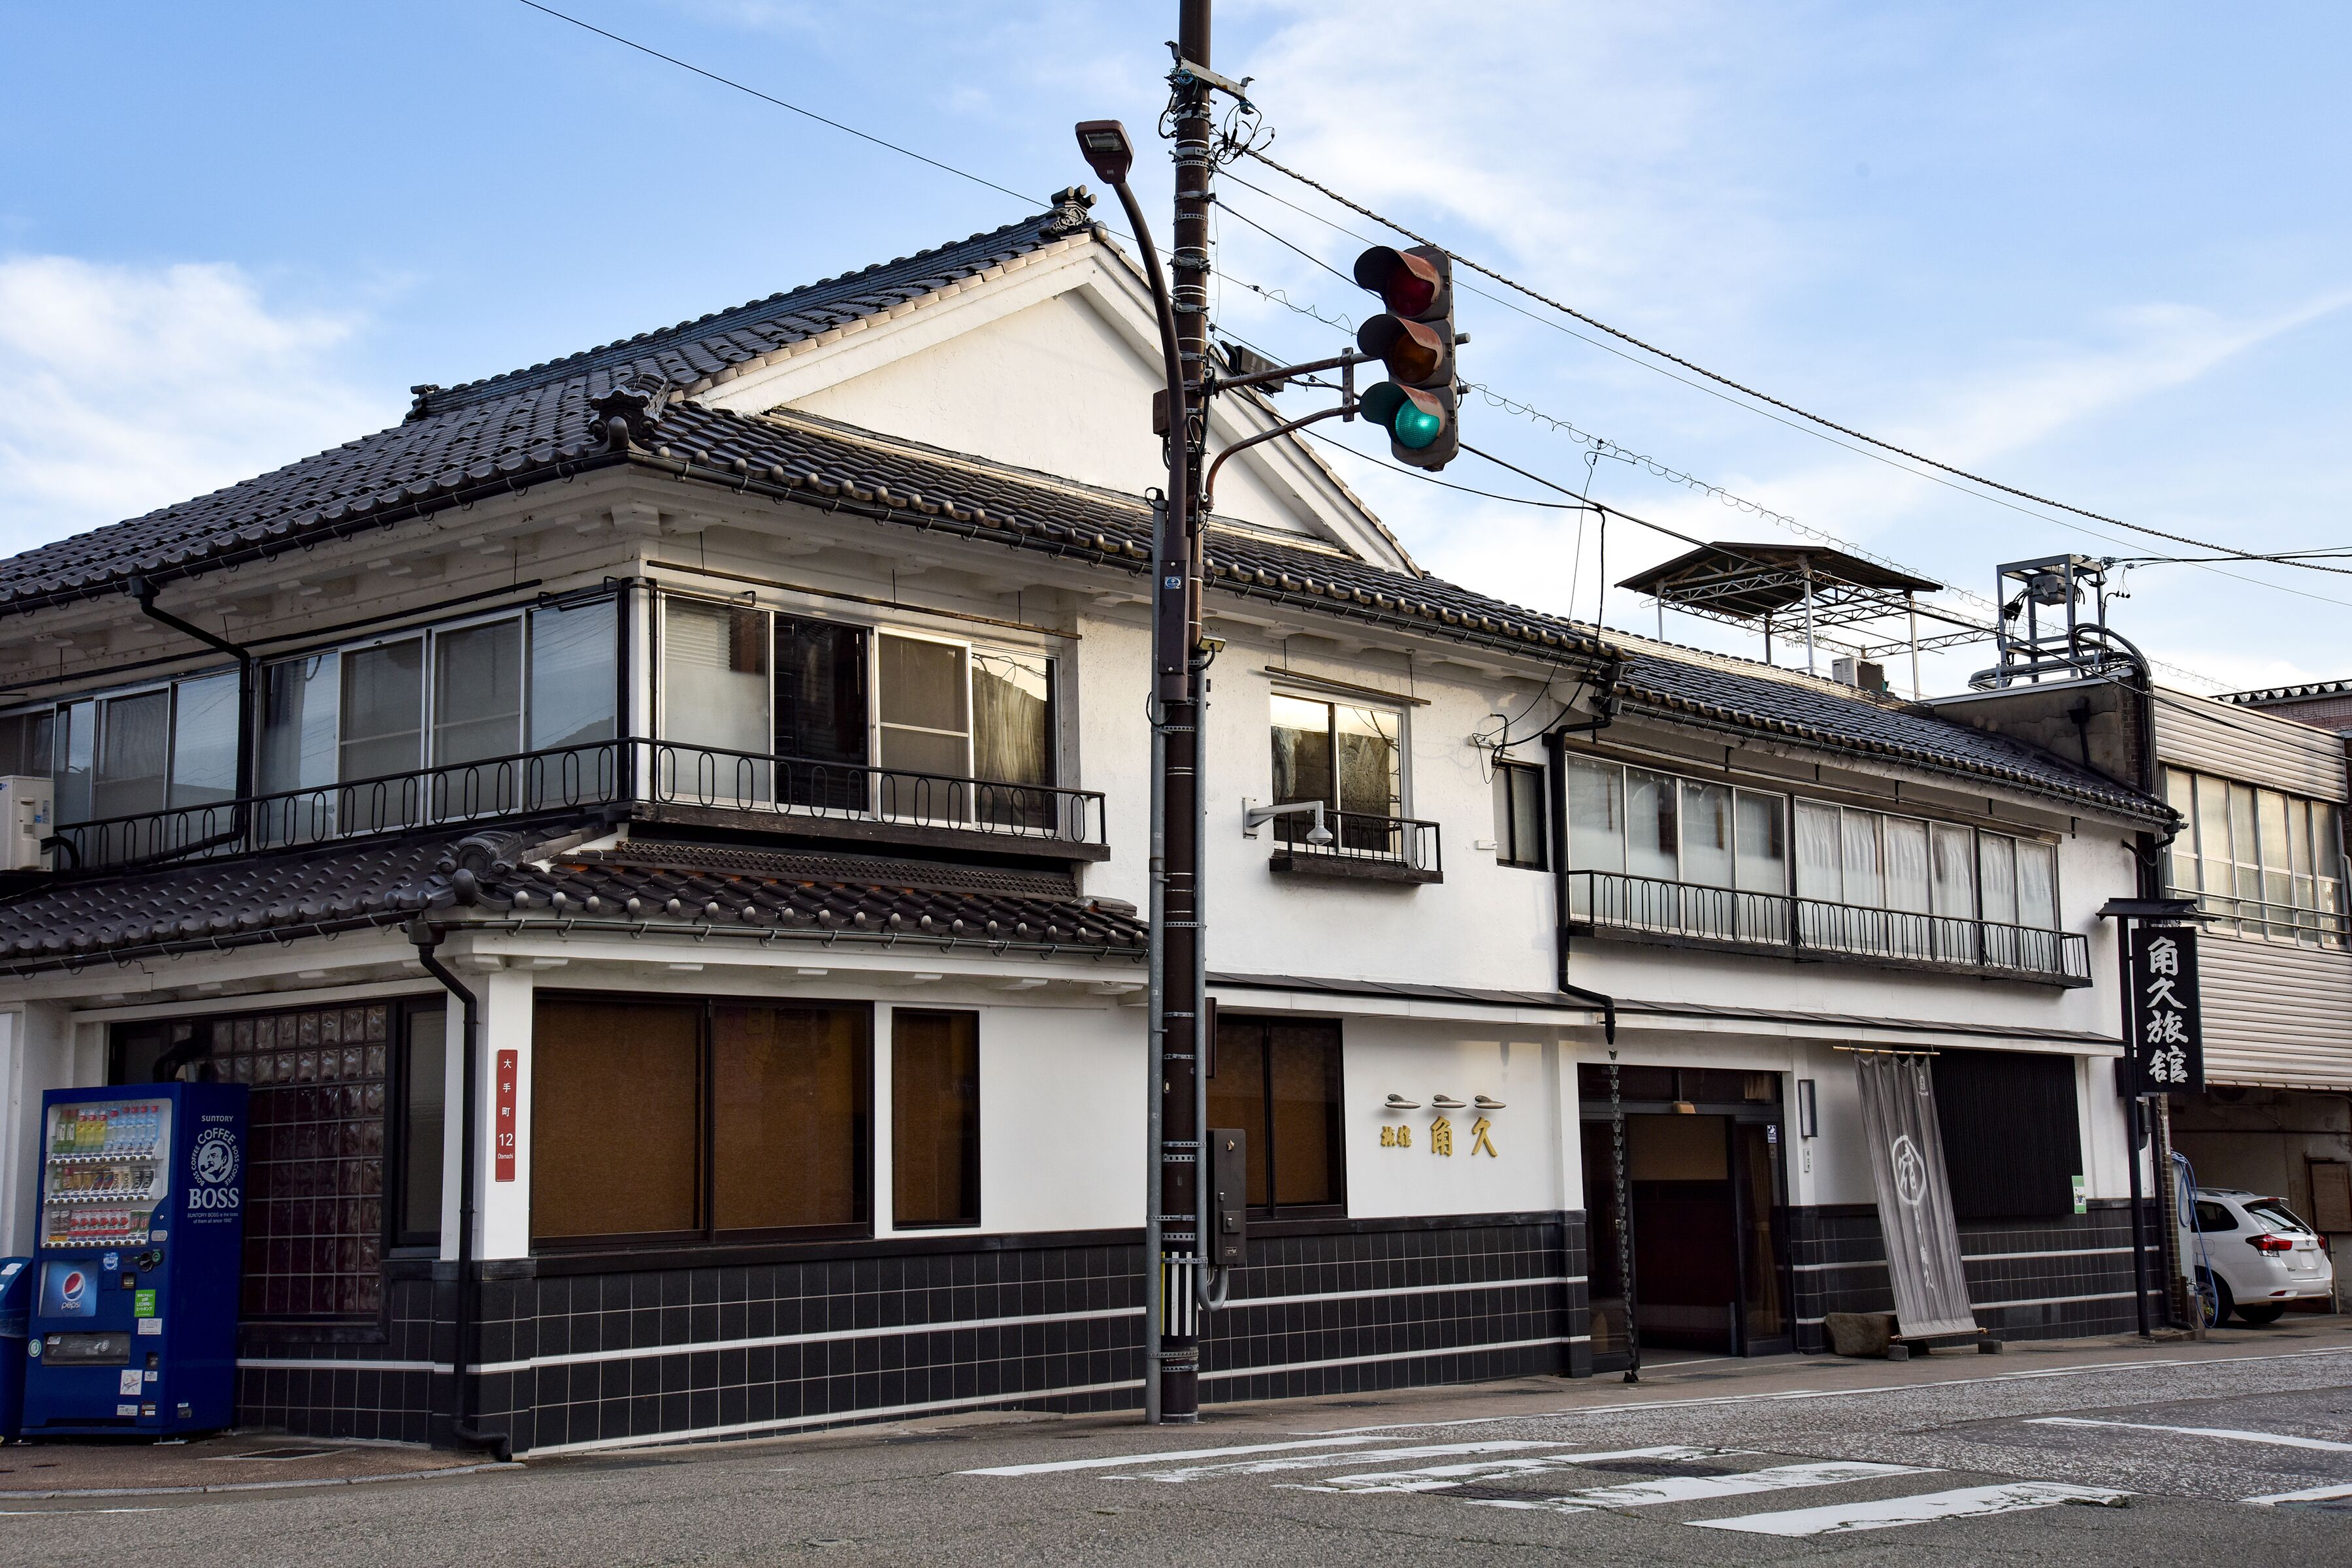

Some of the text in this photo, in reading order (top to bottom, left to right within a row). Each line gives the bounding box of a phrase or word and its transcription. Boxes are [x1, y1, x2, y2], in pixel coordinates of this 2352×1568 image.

[499, 1058, 513, 1146] 大手町 12
[197, 1128, 237, 1145] COFFEE
[191, 1145, 205, 1186] BOSS COFFEE
[224, 1145, 240, 1186] BOSS COFFEE
[188, 1187, 239, 1209] BOSS
[61, 1301, 82, 1310] pepsi
